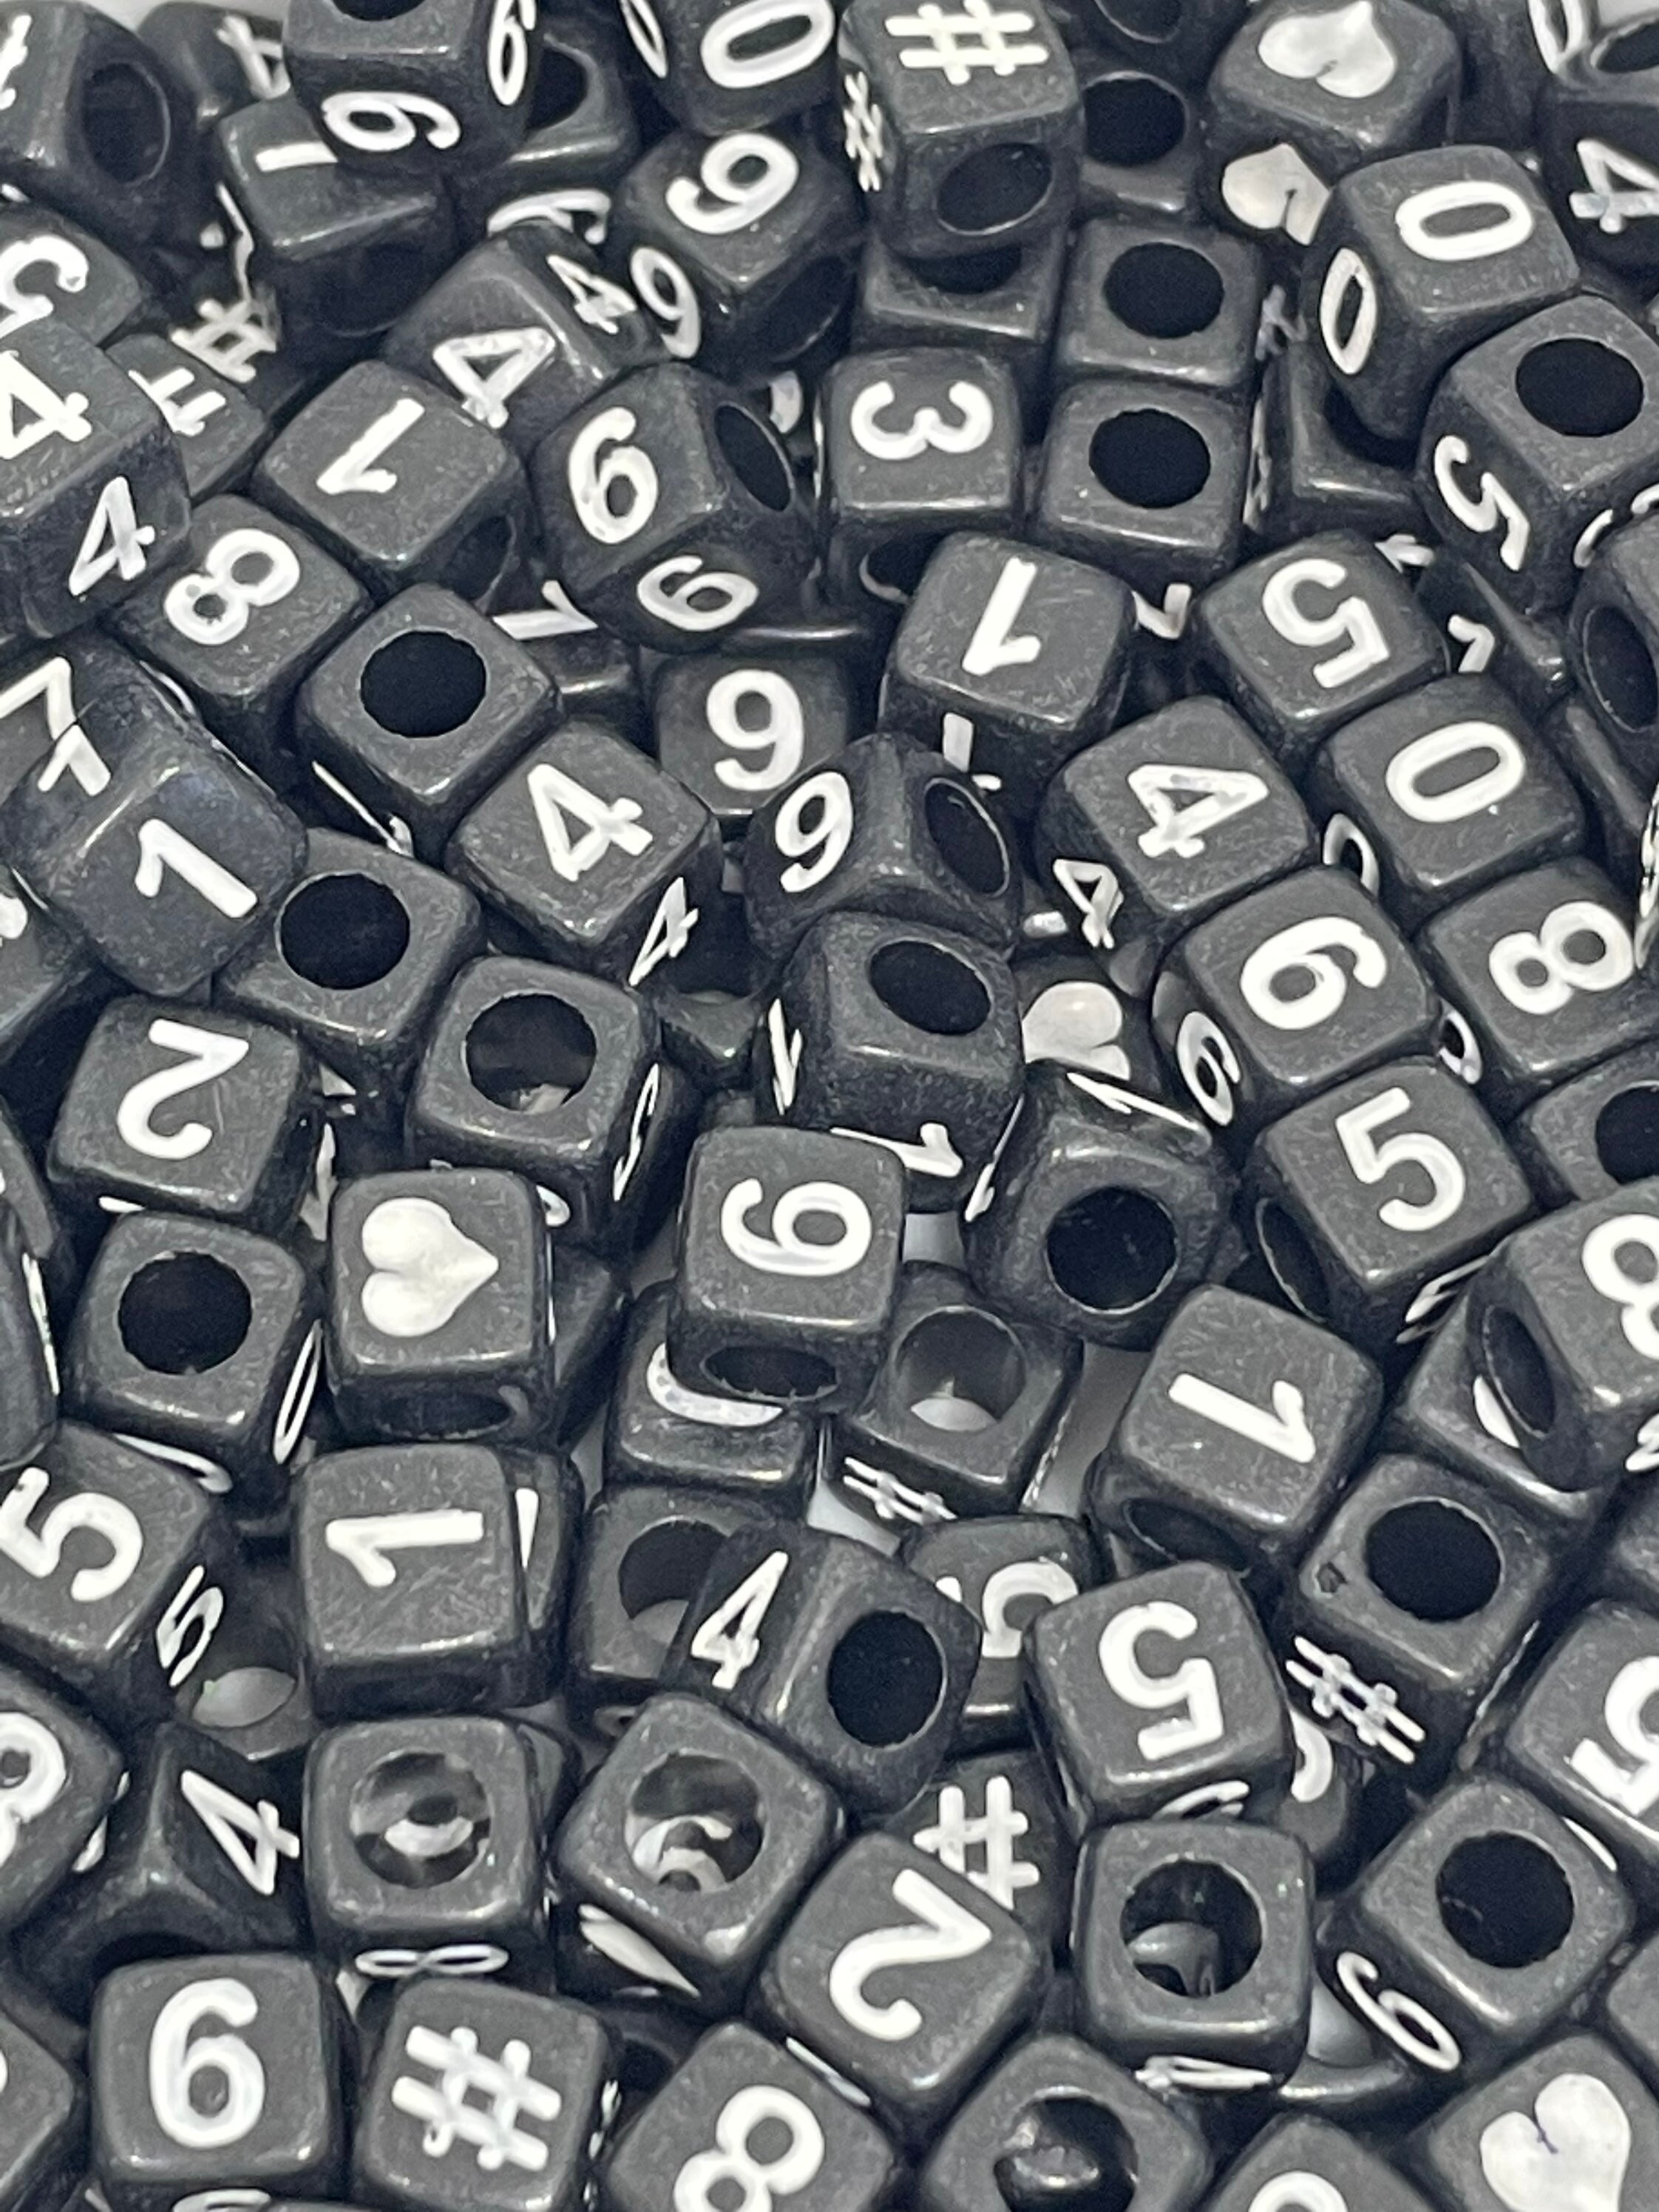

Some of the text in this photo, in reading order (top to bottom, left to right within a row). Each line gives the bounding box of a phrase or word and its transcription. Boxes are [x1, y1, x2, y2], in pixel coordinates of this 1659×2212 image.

[700, 0, 835, 89] 0
[883, 0, 1051, 87] #
[844, 72, 883, 191] #
[1569, 139, 1659, 234] 4
[1394, 178, 1536, 262] 0
[546, 254, 637, 335] 4
[630, 247, 700, 359] 9
[1320, 248, 1378, 375] 0
[434, 328, 556, 429] 4
[849, 379, 994, 461] 3
[315, 396, 427, 496] 1
[567, 406, 659, 545] 6
[1434, 435, 1530, 571] 5
[68, 475, 156, 597] 4
[163, 527, 302, 646] 8
[961, 554, 1043, 677] 1
[1261, 557, 1391, 689] 5
[705, 668, 805, 793] 9
[1385, 720, 1527, 824] 0
[133, 818, 258, 919] 1
[526, 762, 654, 883] 4
[774, 771, 854, 893] 9
[1127, 764, 1270, 860] 4
[628, 876, 699, 987] 4
[1053, 859, 1125, 948] 4
[1488, 901, 1634, 1014] 8
[1239, 916, 1388, 1031] 6
[115, 1018, 250, 1161] 2
[1334, 1086, 1467, 1232] 5
[1167, 1372, 1317, 1465] 1
[0, 1466, 144, 1603] 5
[325, 1510, 484, 1587] 1
[155, 1564, 224, 1687] 5
[691, 1550, 790, 1688] 4
[1098, 1600, 1225, 1763] 5
[1285, 1635, 1425, 1764] #
[180, 1769, 301, 1896] 4
[912, 1775, 1041, 1911] #
[828, 1867, 994, 2042] 2
[1336, 1952, 1460, 2071] 6
[148, 1977, 266, 2150] 6
[390, 2024, 563, 2173] #
[672, 2084, 826, 2212] 8
